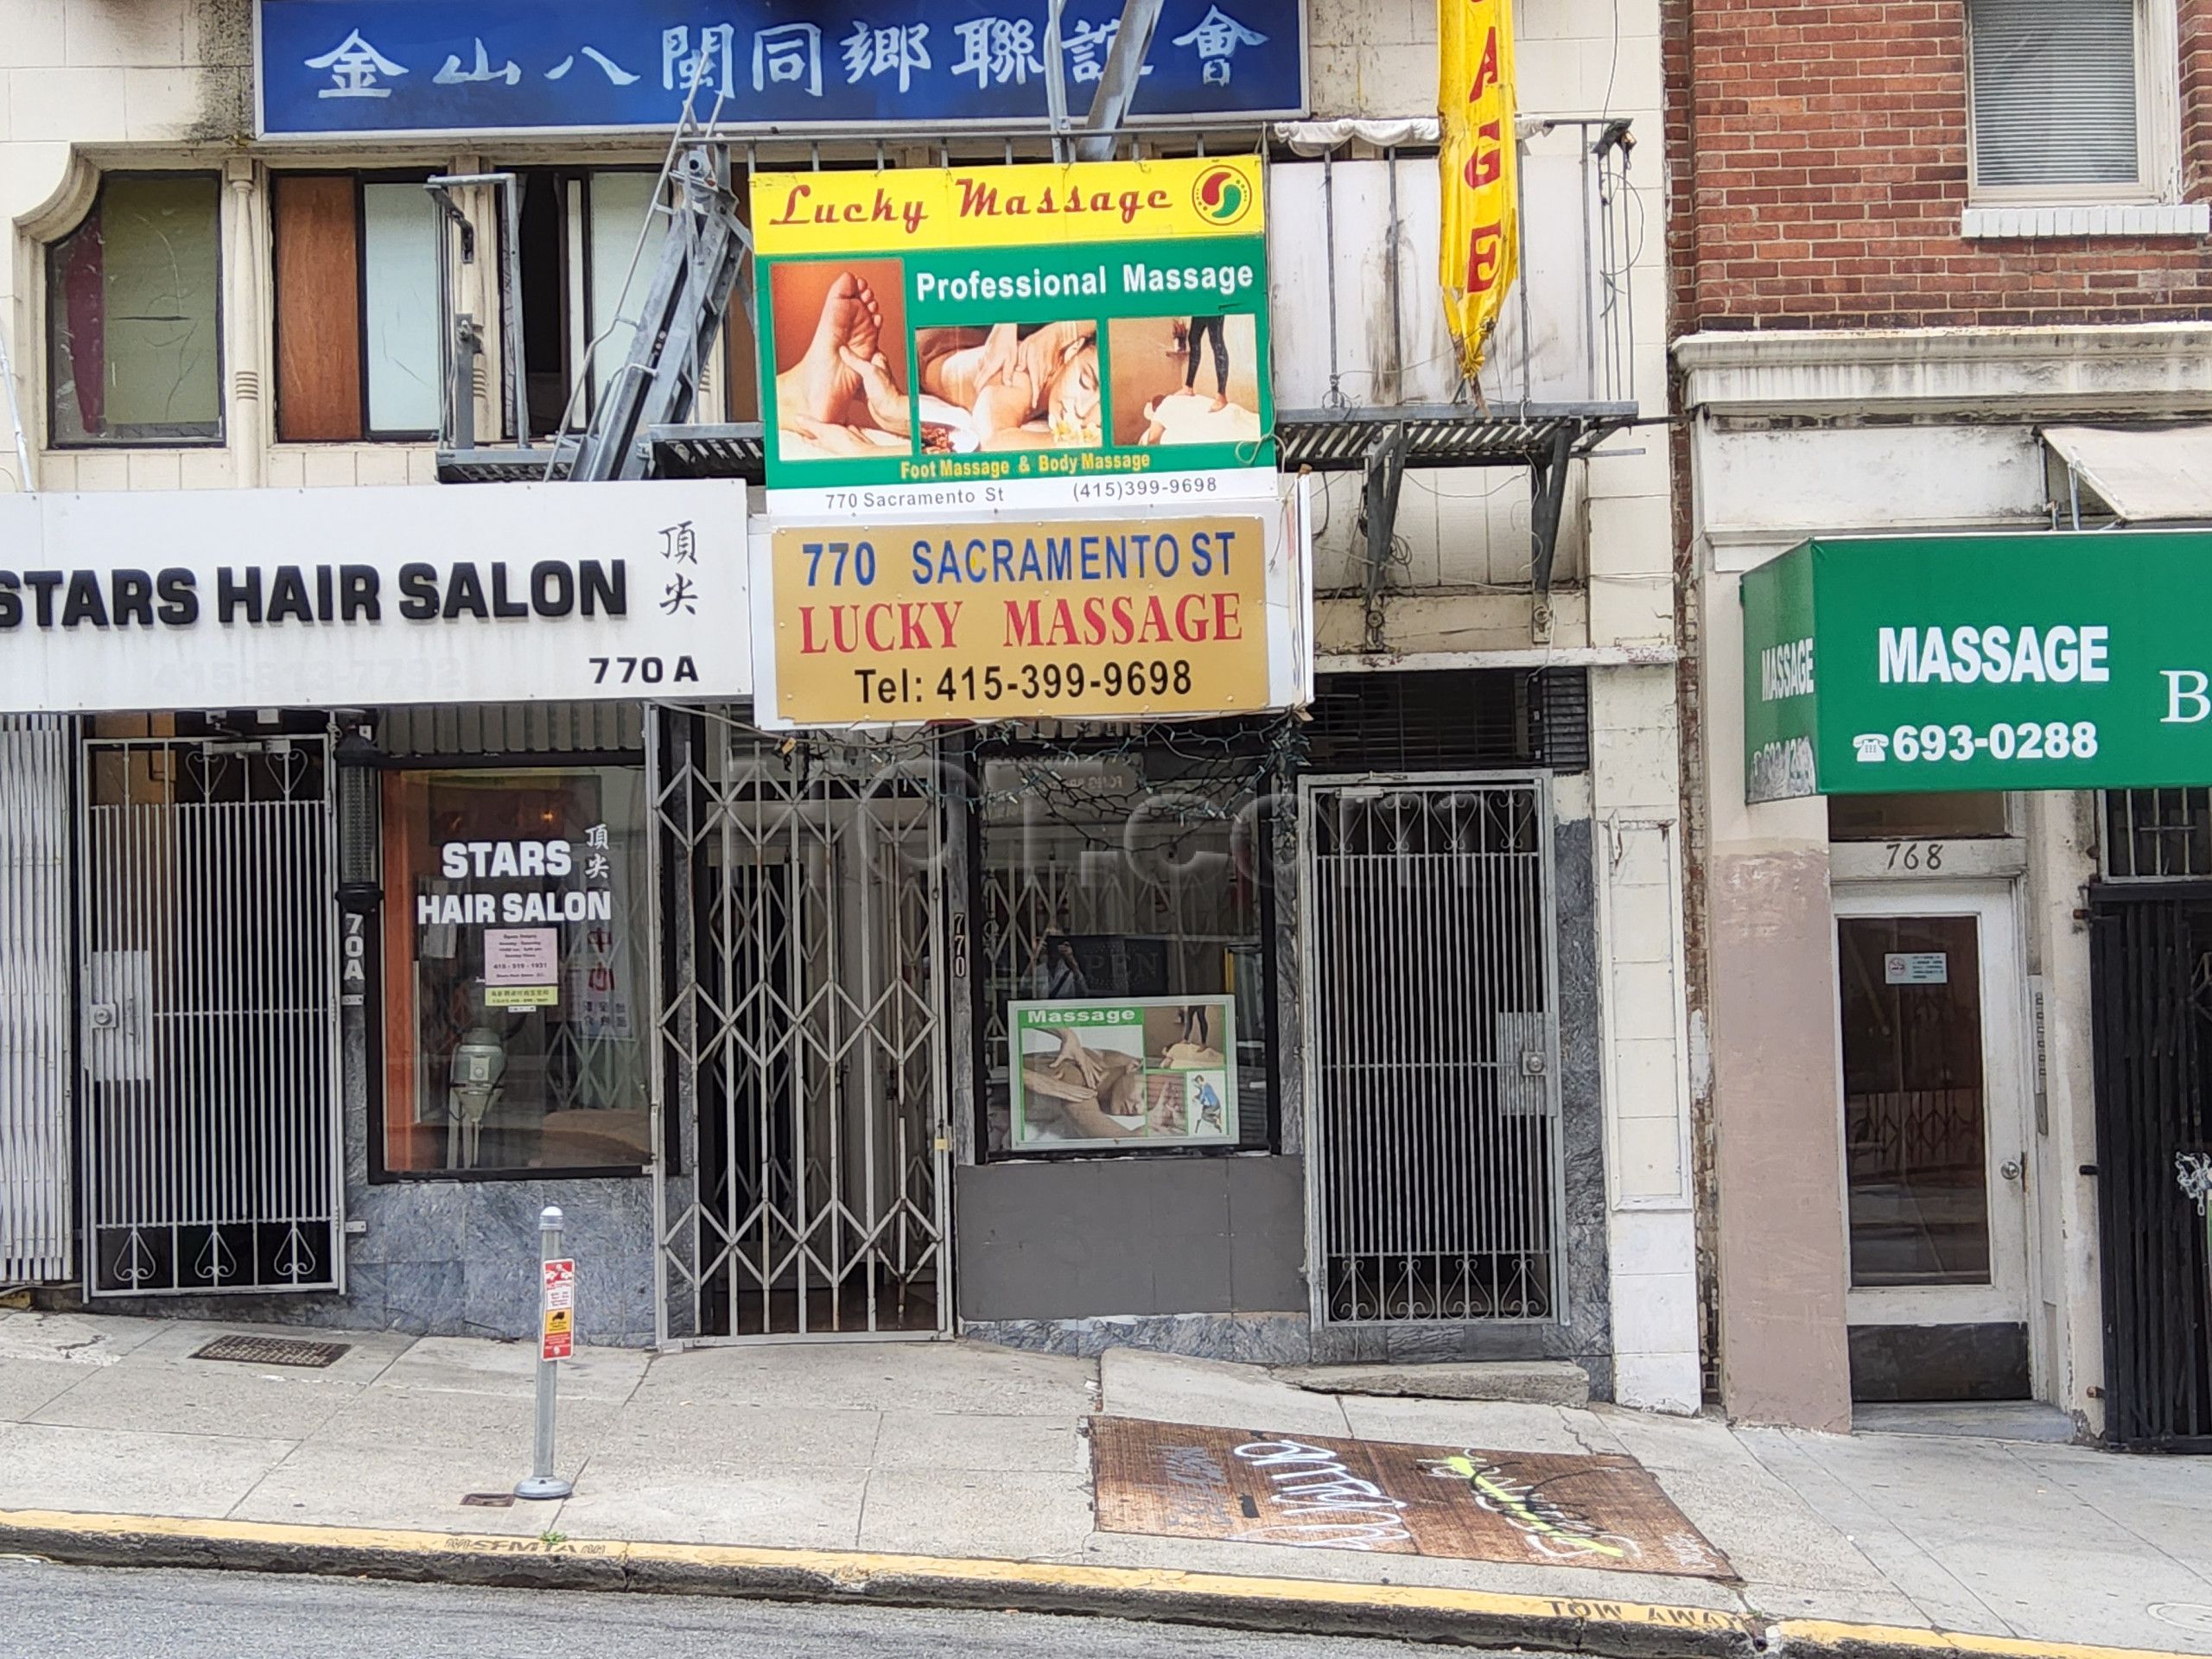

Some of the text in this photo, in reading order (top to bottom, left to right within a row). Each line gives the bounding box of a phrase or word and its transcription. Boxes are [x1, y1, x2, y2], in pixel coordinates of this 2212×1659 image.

[1465, 0, 1502, 293] AGE
[769, 178, 1173, 234] Lucky Massage
[917, 263, 1254, 302] Professional Massage
[900, 453, 1151, 480] Foot Massage & Body Massage
[825, 487, 1004, 509] 770 Sacramento St
[1072, 477, 1217, 502] (415)399-9698
[658, 520, 698, 616] 頂尖
[803, 531, 1236, 587] 770 SACRAMENTO ST
[216, 563, 382, 622] HAIR
[397, 559, 627, 620] SALON
[798, 592, 1243, 654] LUCKY MASSAGE
[1762, 638, 1815, 701] MASSAGE
[1878, 625, 2110, 683] MASSAGE
[855, 660, 1192, 704] Tel: 415-399-9698
[2159, 671, 2212, 723] B
[1892, 721, 2098, 761] 693-0288
[442, 841, 571, 878] STARS
[585, 823, 609, 879] 頂尖
[1885, 844, 1942, 870] 768
[417, 891, 611, 925] HAIR SALON
[954, 912, 966, 977] 770
[1027, 1008, 1135, 1023] Massage
[469, 1540, 576, 1554] SFMTA
[1543, 1600, 1622, 1620] TOW
